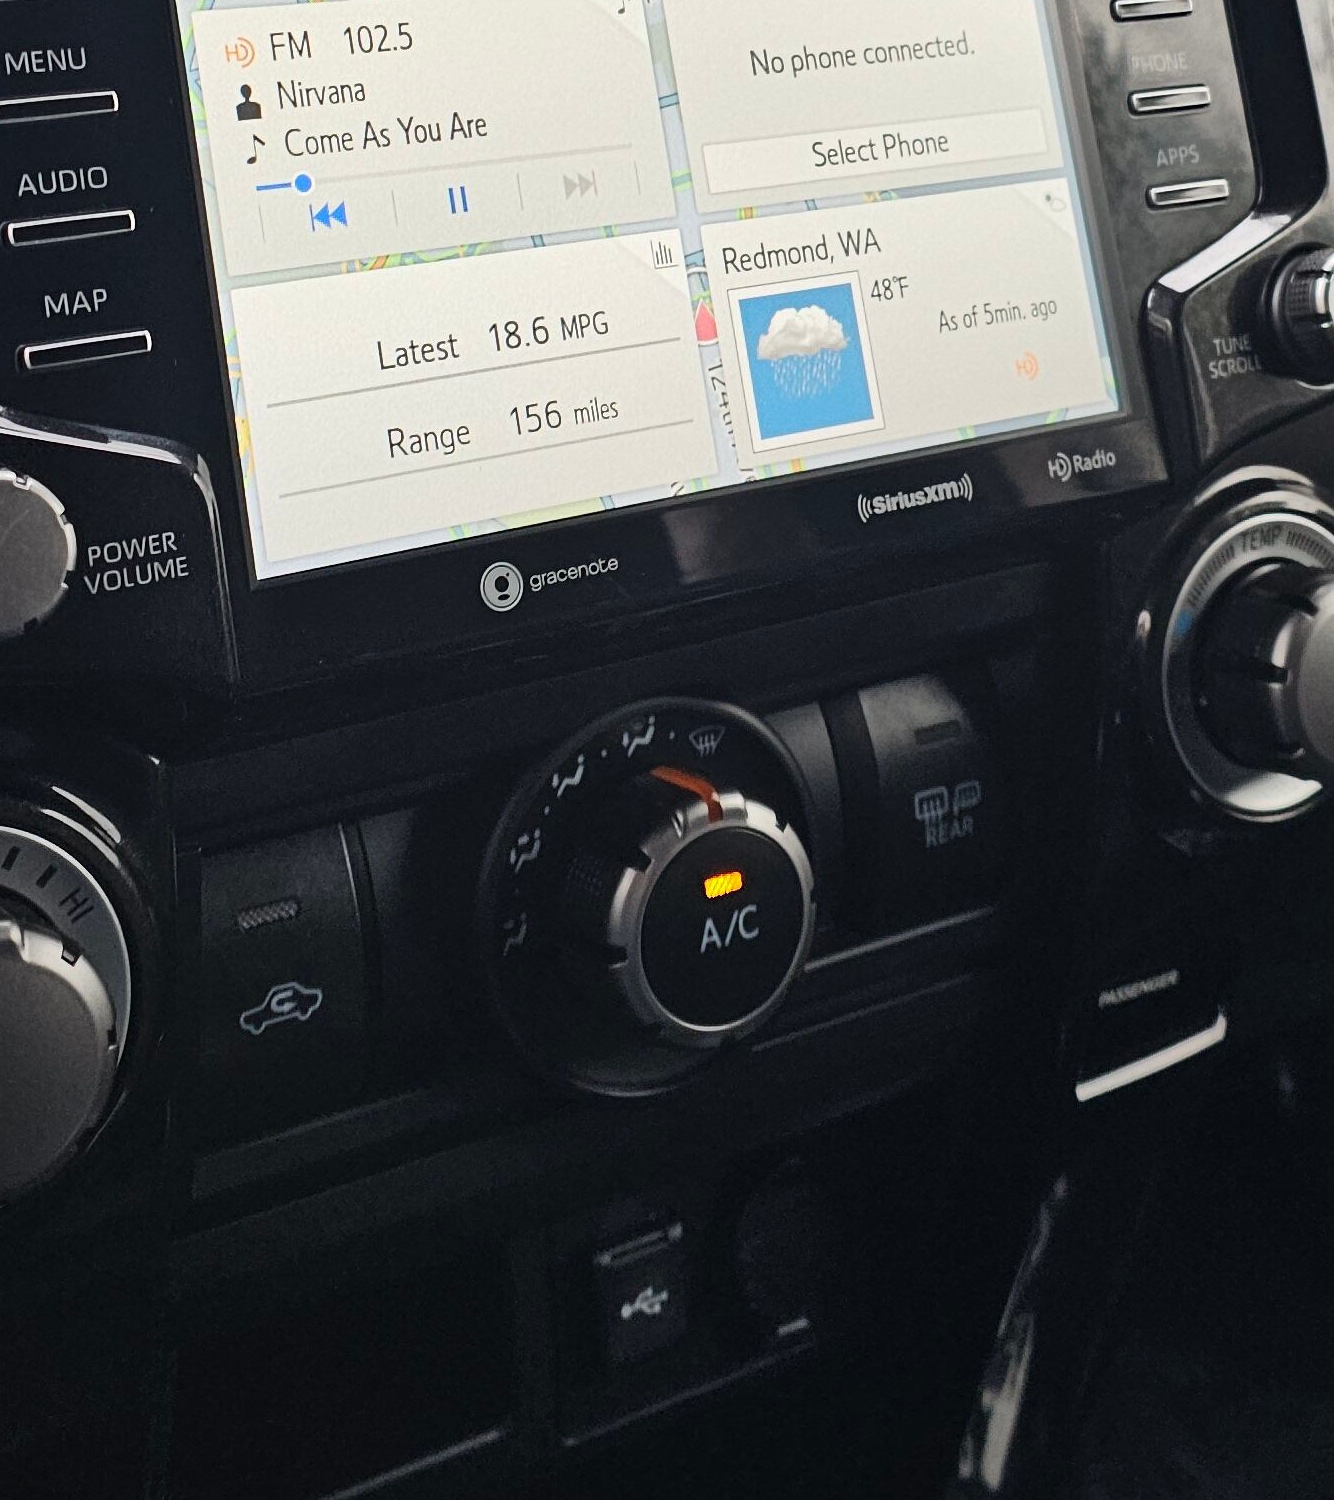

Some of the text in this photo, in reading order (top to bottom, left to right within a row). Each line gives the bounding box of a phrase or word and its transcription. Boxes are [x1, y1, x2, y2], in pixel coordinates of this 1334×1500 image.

[269, 22, 414, 61] FM 102.5
[750, 31, 976, 79] No phone connected.
[4, 47, 88, 76] MENU
[276, 78, 366, 110] Nirvana
[284, 111, 488, 158] Come As You Are
[812, 131, 951, 168] Select Phone
[1157, 145, 1200, 167] APPS
[18, 166, 109, 197] AUDIO
[722, 228, 881, 275] Redmond, WA
[44, 288, 109, 318] MAP
[938, 299, 1058, 334] As of 5min. ago
[377, 311, 609, 370] Latest 18.6 MPG
[1213, 334, 1252, 357] TUNE
[388, 397, 619, 458] Range 156 miles
[1073, 449, 1116, 475] Radio
[87, 531, 178, 567] POWER
[1241, 526, 1282, 551] TEMP
[84, 556, 189, 595] VOLUME
[529, 555, 619, 592] gracenote
[925, 815, 975, 849] REAR
[699, 904, 760, 953] A/C
